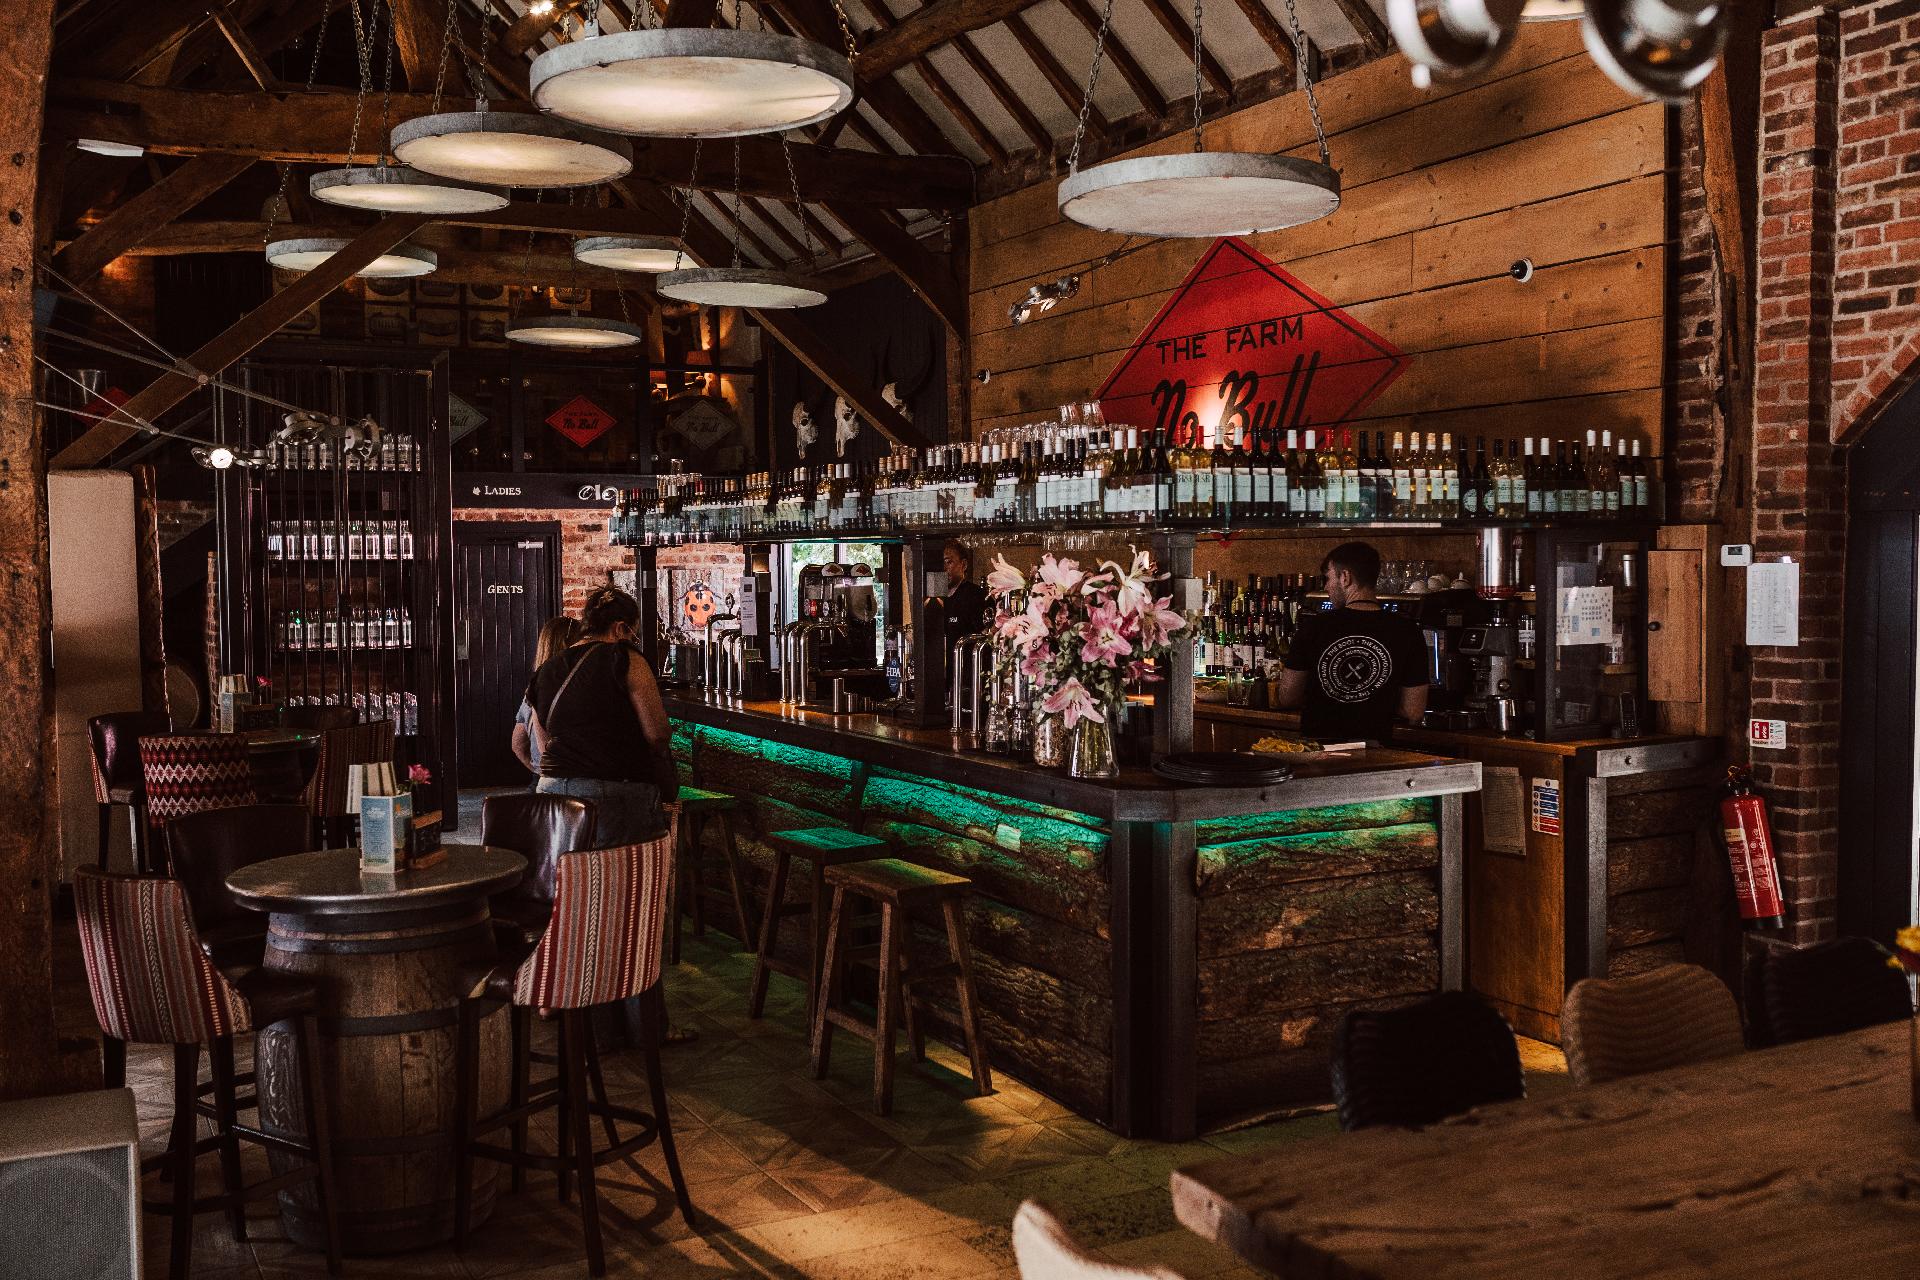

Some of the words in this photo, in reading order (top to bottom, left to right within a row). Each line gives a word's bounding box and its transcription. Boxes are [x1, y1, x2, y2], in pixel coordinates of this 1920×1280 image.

[1156, 335, 1207, 365] THE
[1226, 316, 1303, 353] FARM
[1151, 378, 1199, 450] No
[1219, 351, 1323, 449] Bull
[578, 417, 599, 429] Bull
[1361, 639, 1373, 648] THE
[1327, 646, 1339, 657] THE
